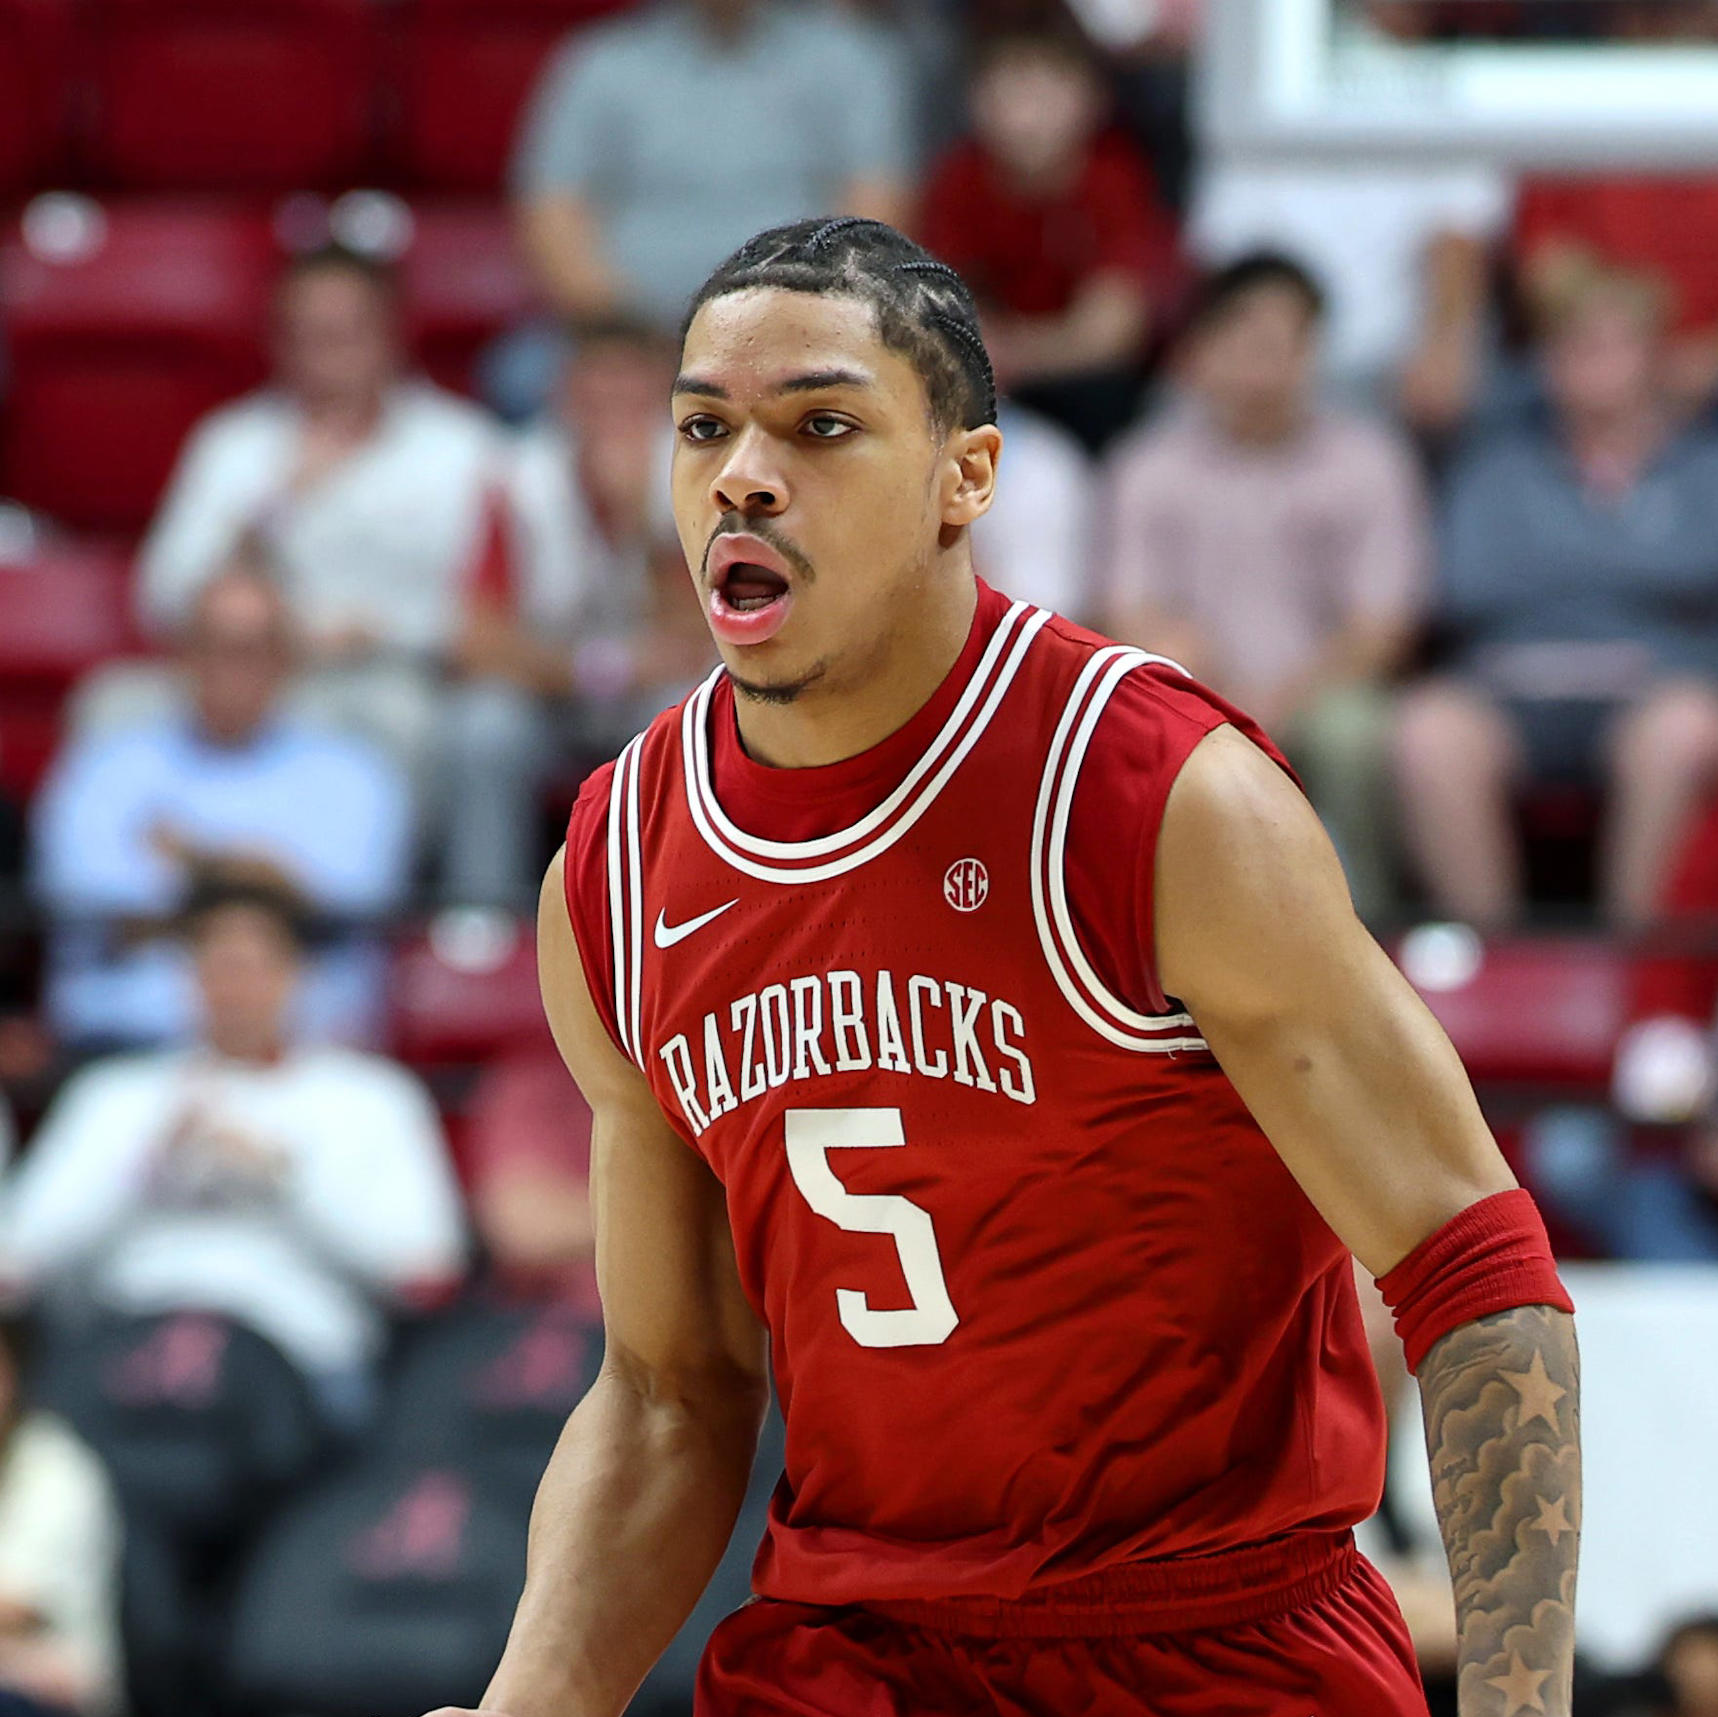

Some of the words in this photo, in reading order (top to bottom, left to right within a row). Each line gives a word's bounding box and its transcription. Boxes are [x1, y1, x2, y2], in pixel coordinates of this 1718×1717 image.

[943, 858, 989, 912] SEC
[660, 970, 1036, 1136] RAZORBACKS
[785, 1108, 959, 1347] 5
